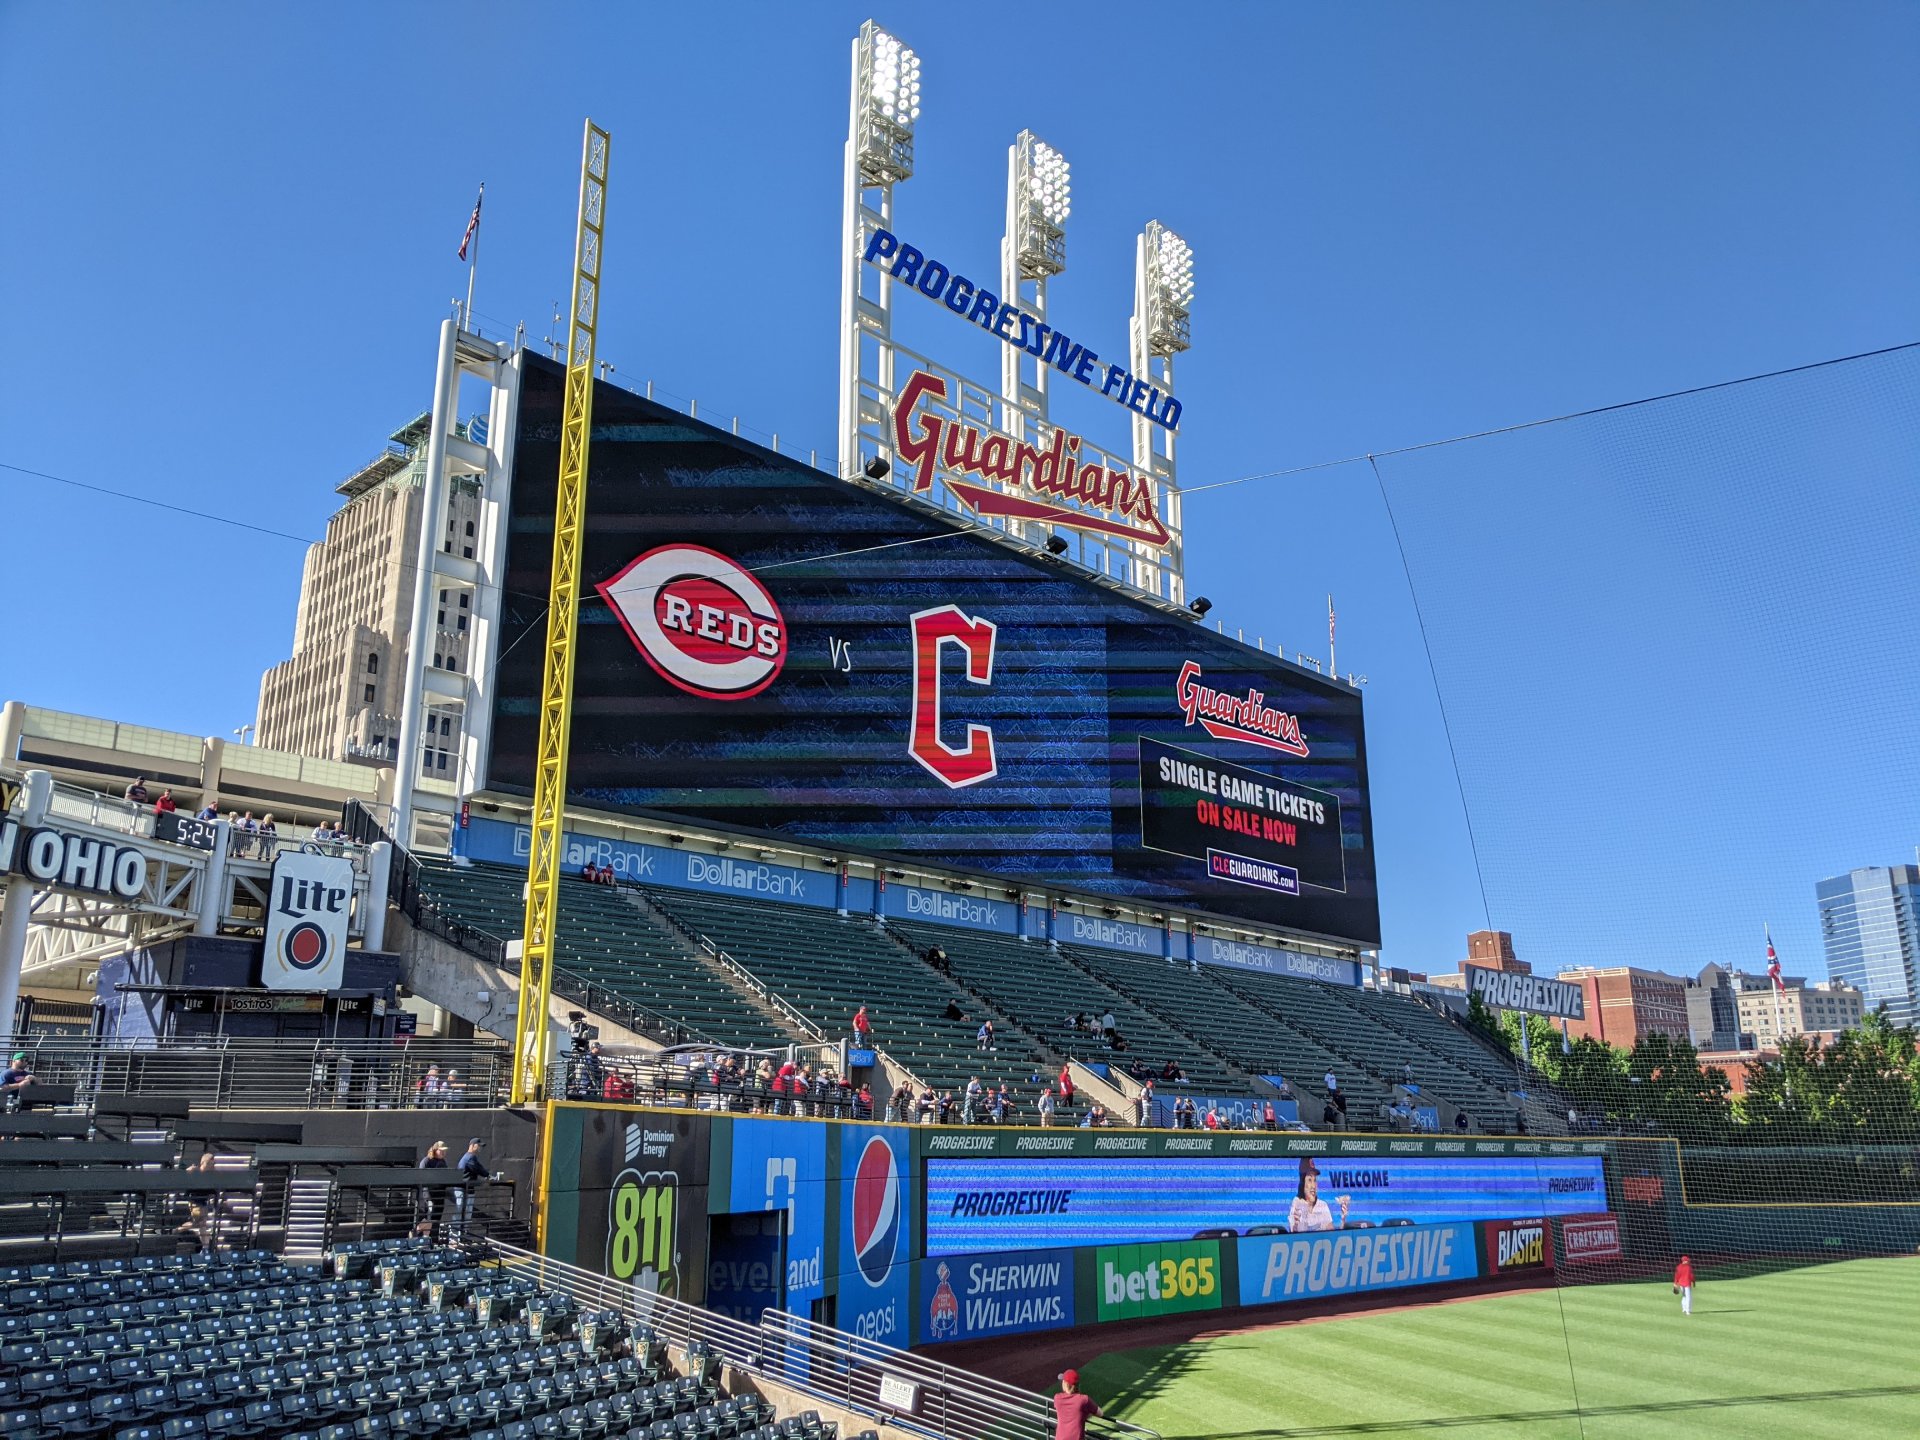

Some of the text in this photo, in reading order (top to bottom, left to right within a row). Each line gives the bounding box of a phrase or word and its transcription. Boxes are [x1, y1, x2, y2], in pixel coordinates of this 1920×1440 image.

[864, 227, 1183, 431] PROGRESSIVE FIELD
[891, 369, 1158, 528] Guardians
[661, 593, 781, 657] REDS
[908, 603, 997, 789] C
[1177, 660, 1303, 743] Guardians
[1160, 756, 1325, 825] SINGLE GAME TICKETS
[178, 819, 216, 847] 5:24
[1197, 799, 1297, 847] ON SALE NOW
[27, 831, 147, 896] OHIO
[687, 854, 804, 897] DollarBank
[277, 876, 346, 918] Lite
[907, 889, 997, 925] DollarBank
[1074, 916, 1147, 949] DollarBank
[1212, 940, 1273, 968] DollarBank
[1286, 953, 1341, 979] DollarBank
[340, 1000, 358, 1012] Lite
[1473, 968, 1582, 1017] PROGRESSIVE
[643, 1130, 674, 1143] Dominion
[643, 1145, 667, 1158] Energy
[929, 1136, 996, 1150] PROGRESSIVE
[1016, 1137, 1074, 1150] PROGRESSIVE
[1094, 1137, 1149, 1150] PROGRESSIVE
[1165, 1138, 1213, 1150] PROGRESSIVE
[1229, 1139, 1274, 1151] PROGRESSIVE
[1288, 1139, 1328, 1150] PROGRESSIVE
[1340, 1140, 1378, 1151] PROGRESSIVE
[1390, 1141, 1424, 1151] PROGRESSIVE
[1435, 1142, 1466, 1152] PROGRESSIVE
[1476, 1142, 1505, 1152] PROGRESSIVE
[1329, 1170, 1389, 1188] WELCOME
[1548, 1177, 1595, 1193] PROGRESSIVE
[950, 1190, 1073, 1218] PROGRESSIVE
[612, 1183, 673, 1279] 811
[1568, 1229, 1615, 1249] CRAFTSMAN
[1498, 1227, 1543, 1266] BLASTER
[1262, 1228, 1454, 1298] PROGRESSIVE
[967, 1262, 1060, 1295] SHERWIN
[1104, 1257, 1215, 1304] bet365
[856, 1298, 896, 1353] pepsi
[965, 1296, 1061, 1331] WILLIAMS
